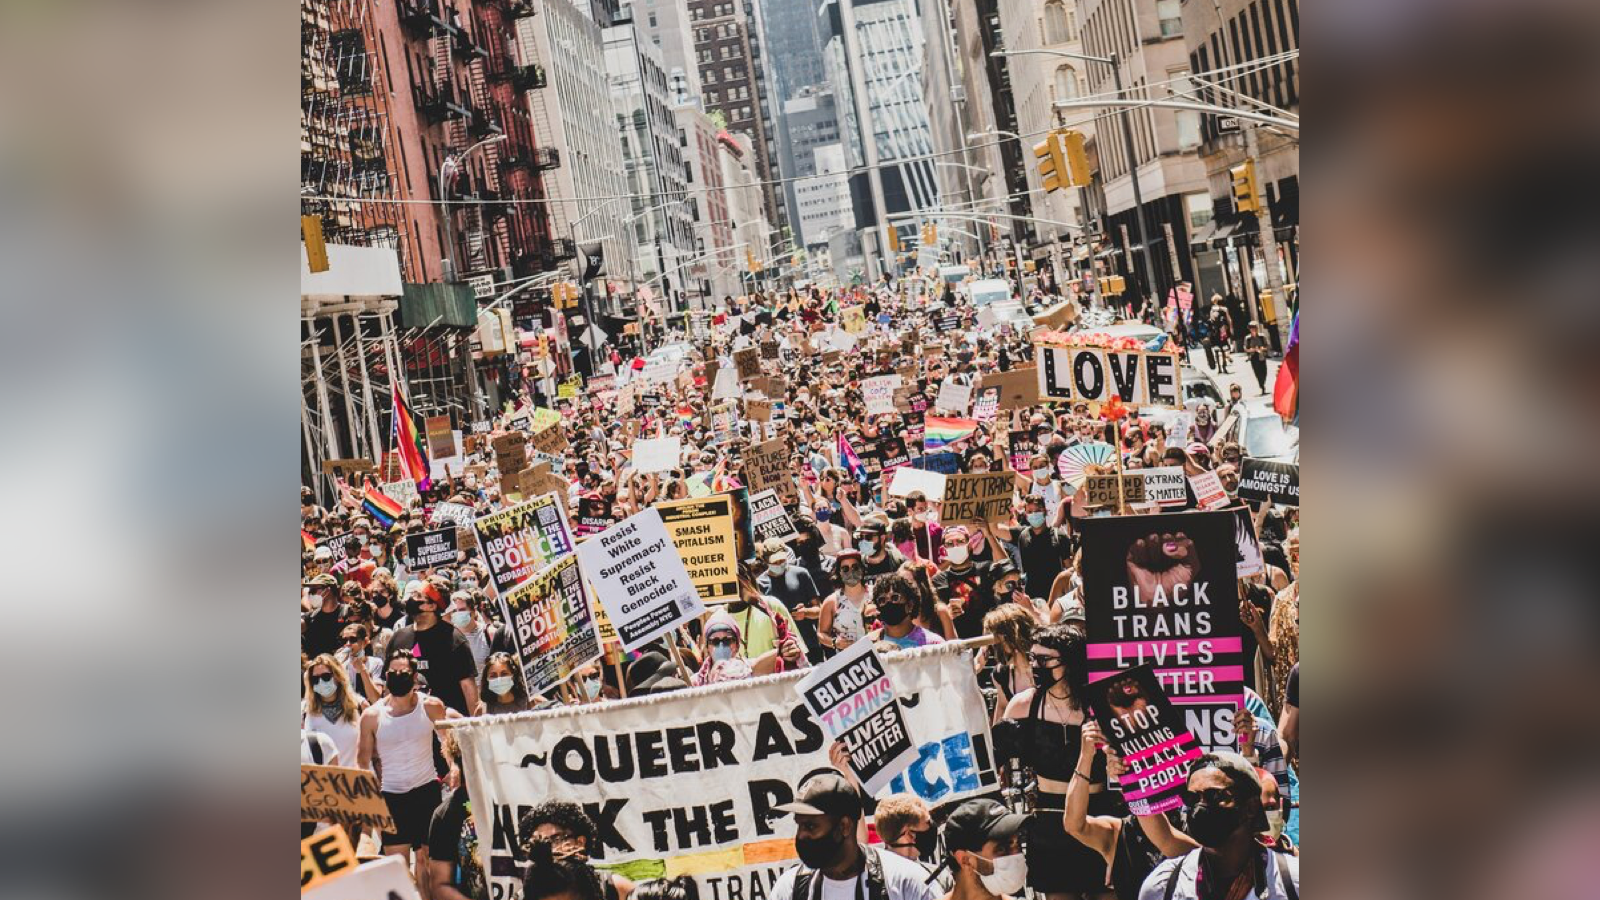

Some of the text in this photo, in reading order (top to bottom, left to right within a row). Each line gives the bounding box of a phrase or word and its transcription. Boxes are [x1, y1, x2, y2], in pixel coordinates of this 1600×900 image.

[1043, 348, 1175, 405] LOVE
[746, 449, 785, 470] FUTURE
[760, 461, 789, 476] BLACK
[945, 475, 1014, 501] BLACK TRANS
[1155, 474, 1184, 484] TRANS
[1239, 478, 1300, 496] AMONGST US
[1253, 470, 1291, 484] LOVE IS
[1089, 488, 1142, 502] POLCE
[1157, 488, 1185, 500] MATTER
[483, 499, 545, 525] PRIDE MEANS
[942, 499, 1011, 521] LIVES MATTER
[600, 522, 638, 548] Resist
[675, 524, 711, 537] SMASH
[758, 517, 786, 532] LIVES
[425, 534, 443, 545] WHITE
[486, 522, 562, 555] ABOLISH THE
[608, 537, 641, 559] White
[673, 535, 725, 549] APITALISM
[489, 530, 568, 574] POLICE!
[600, 538, 666, 580] Supremacy!
[690, 553, 725, 566] QUEER
[514, 560, 569, 597] PRIDE MEANS
[620, 560, 656, 586] Resist
[627, 574, 659, 597] Black
[515, 581, 581, 628] ABOLISH THE
[621, 579, 678, 615] Genocide!
[1113, 582, 1210, 609] BLACK
[518, 591, 584, 647] POLICE!
[1113, 611, 1212, 638] TRANS
[1116, 640, 1214, 668] LIVES
[813, 656, 881, 710] BLACK
[1155, 670, 1215, 695] TTER
[821, 677, 893, 736] TRANS
[752, 703, 824, 762] AS
[844, 706, 897, 752] LIVES
[1110, 704, 1159, 739] STOP
[851, 722, 904, 771] MATTER
[1120, 726, 1175, 756] KILLING
[1131, 742, 1187, 775] BLACK
[1138, 759, 1192, 793] PEOPLE
[306, 793, 339, 807] GO
[642, 798, 739, 852] THE
